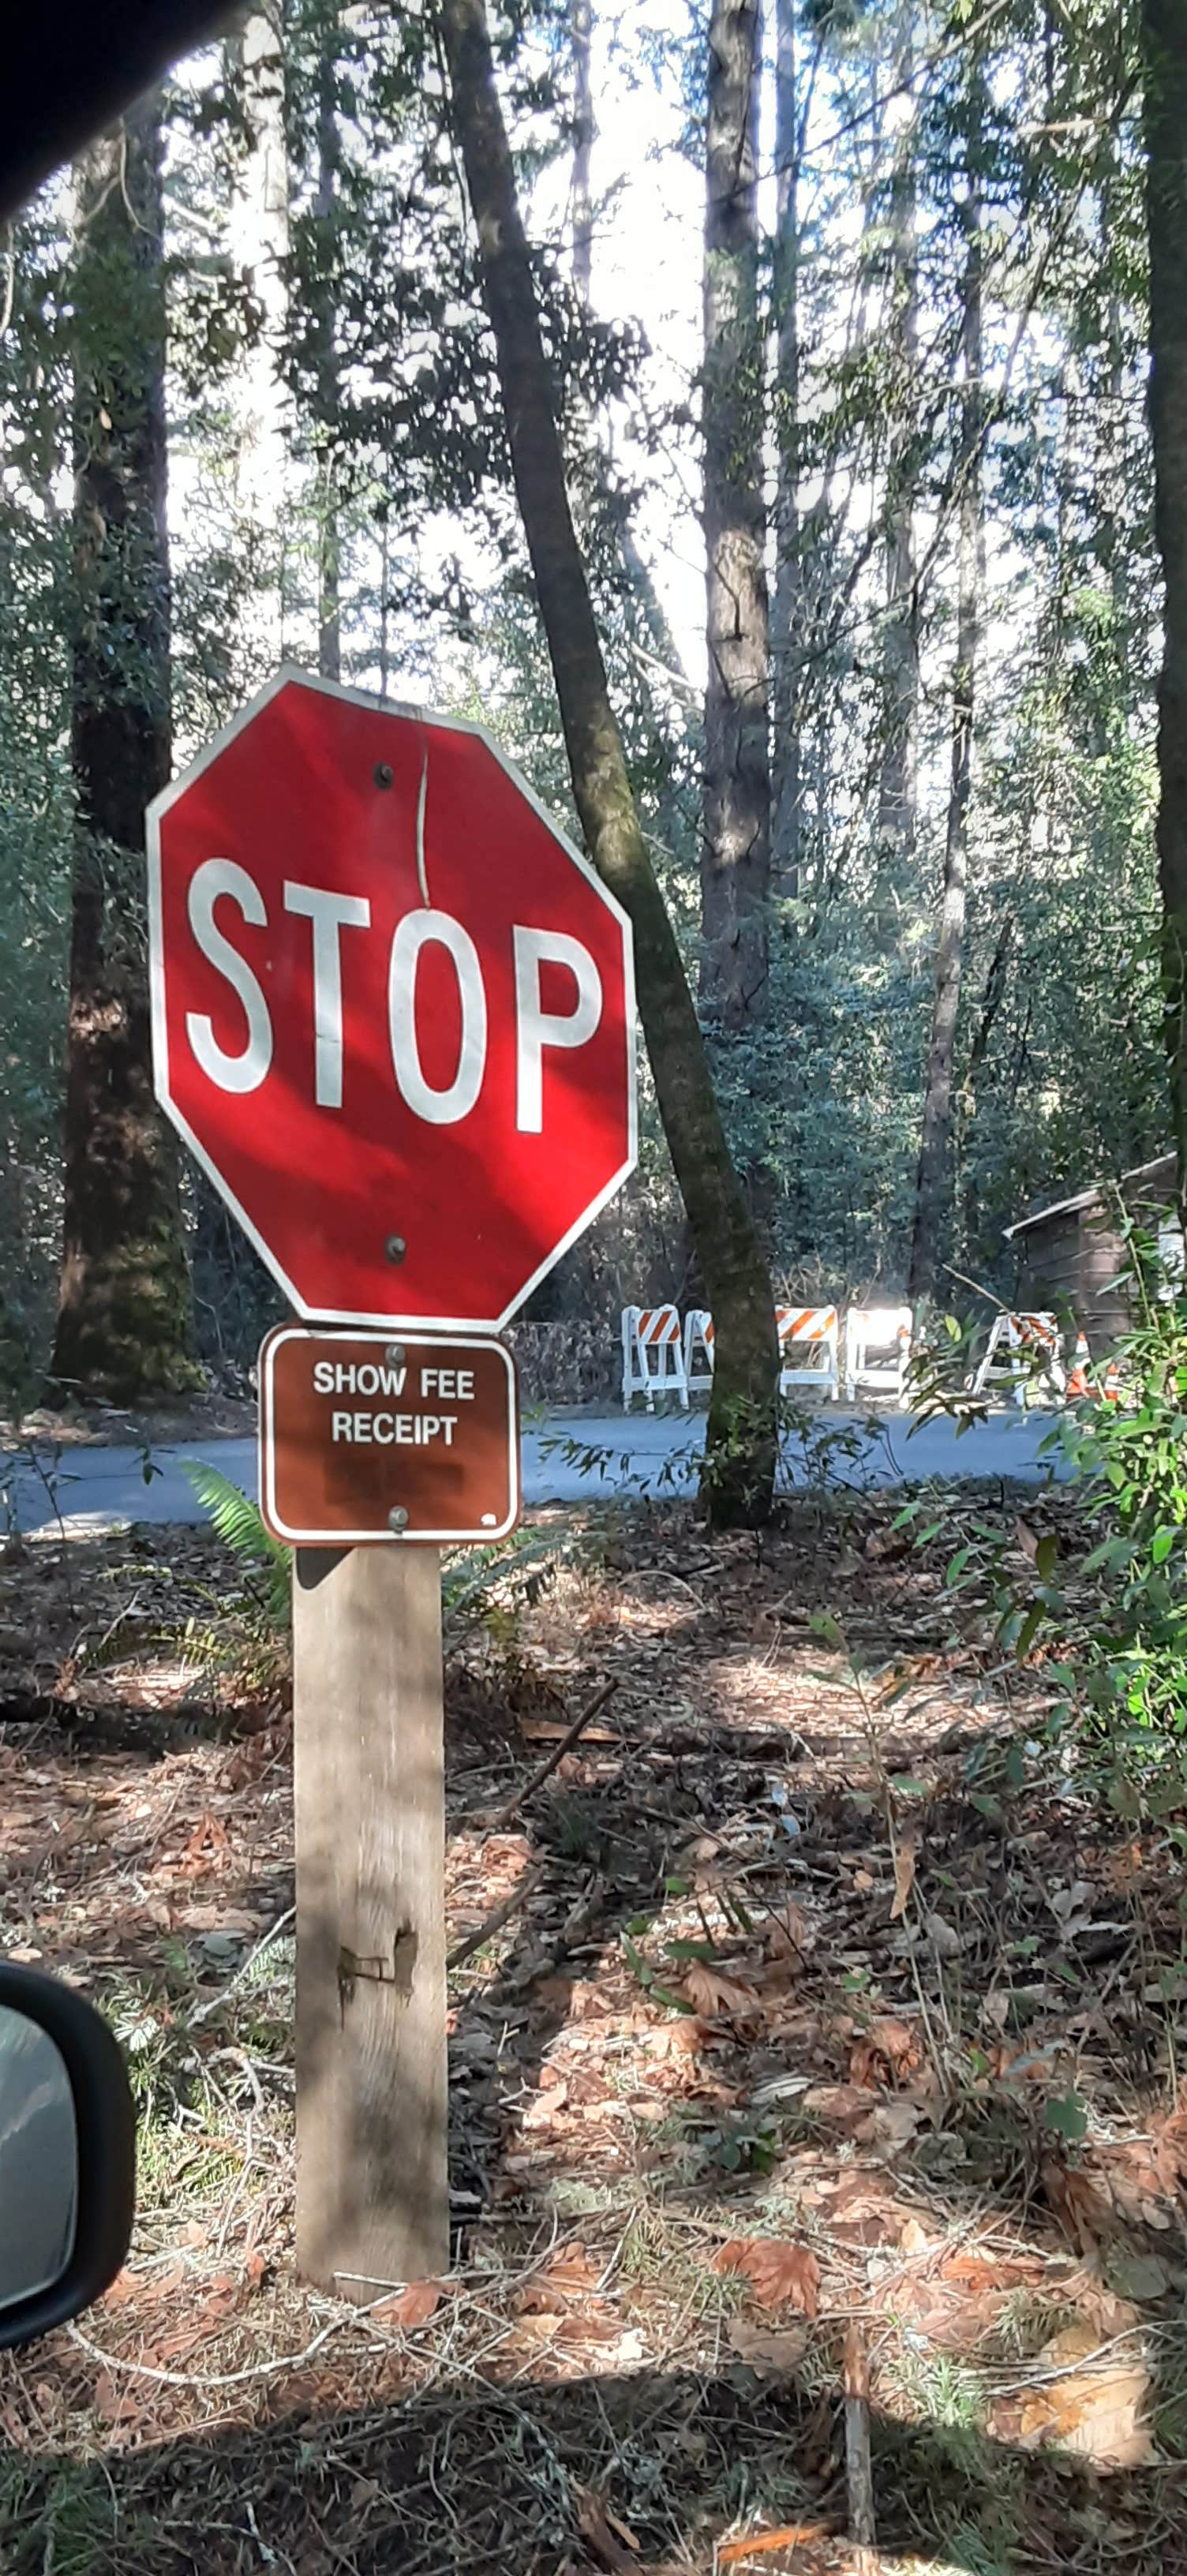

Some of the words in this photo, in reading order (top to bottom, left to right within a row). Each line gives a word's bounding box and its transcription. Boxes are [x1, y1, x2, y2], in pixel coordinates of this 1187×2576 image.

[185, 857, 603, 1134] STOP
[313, 1362, 406, 1396] SHOW
[420, 1368, 474, 1399] FEE
[331, 1411, 458, 1446] RECEIPT
